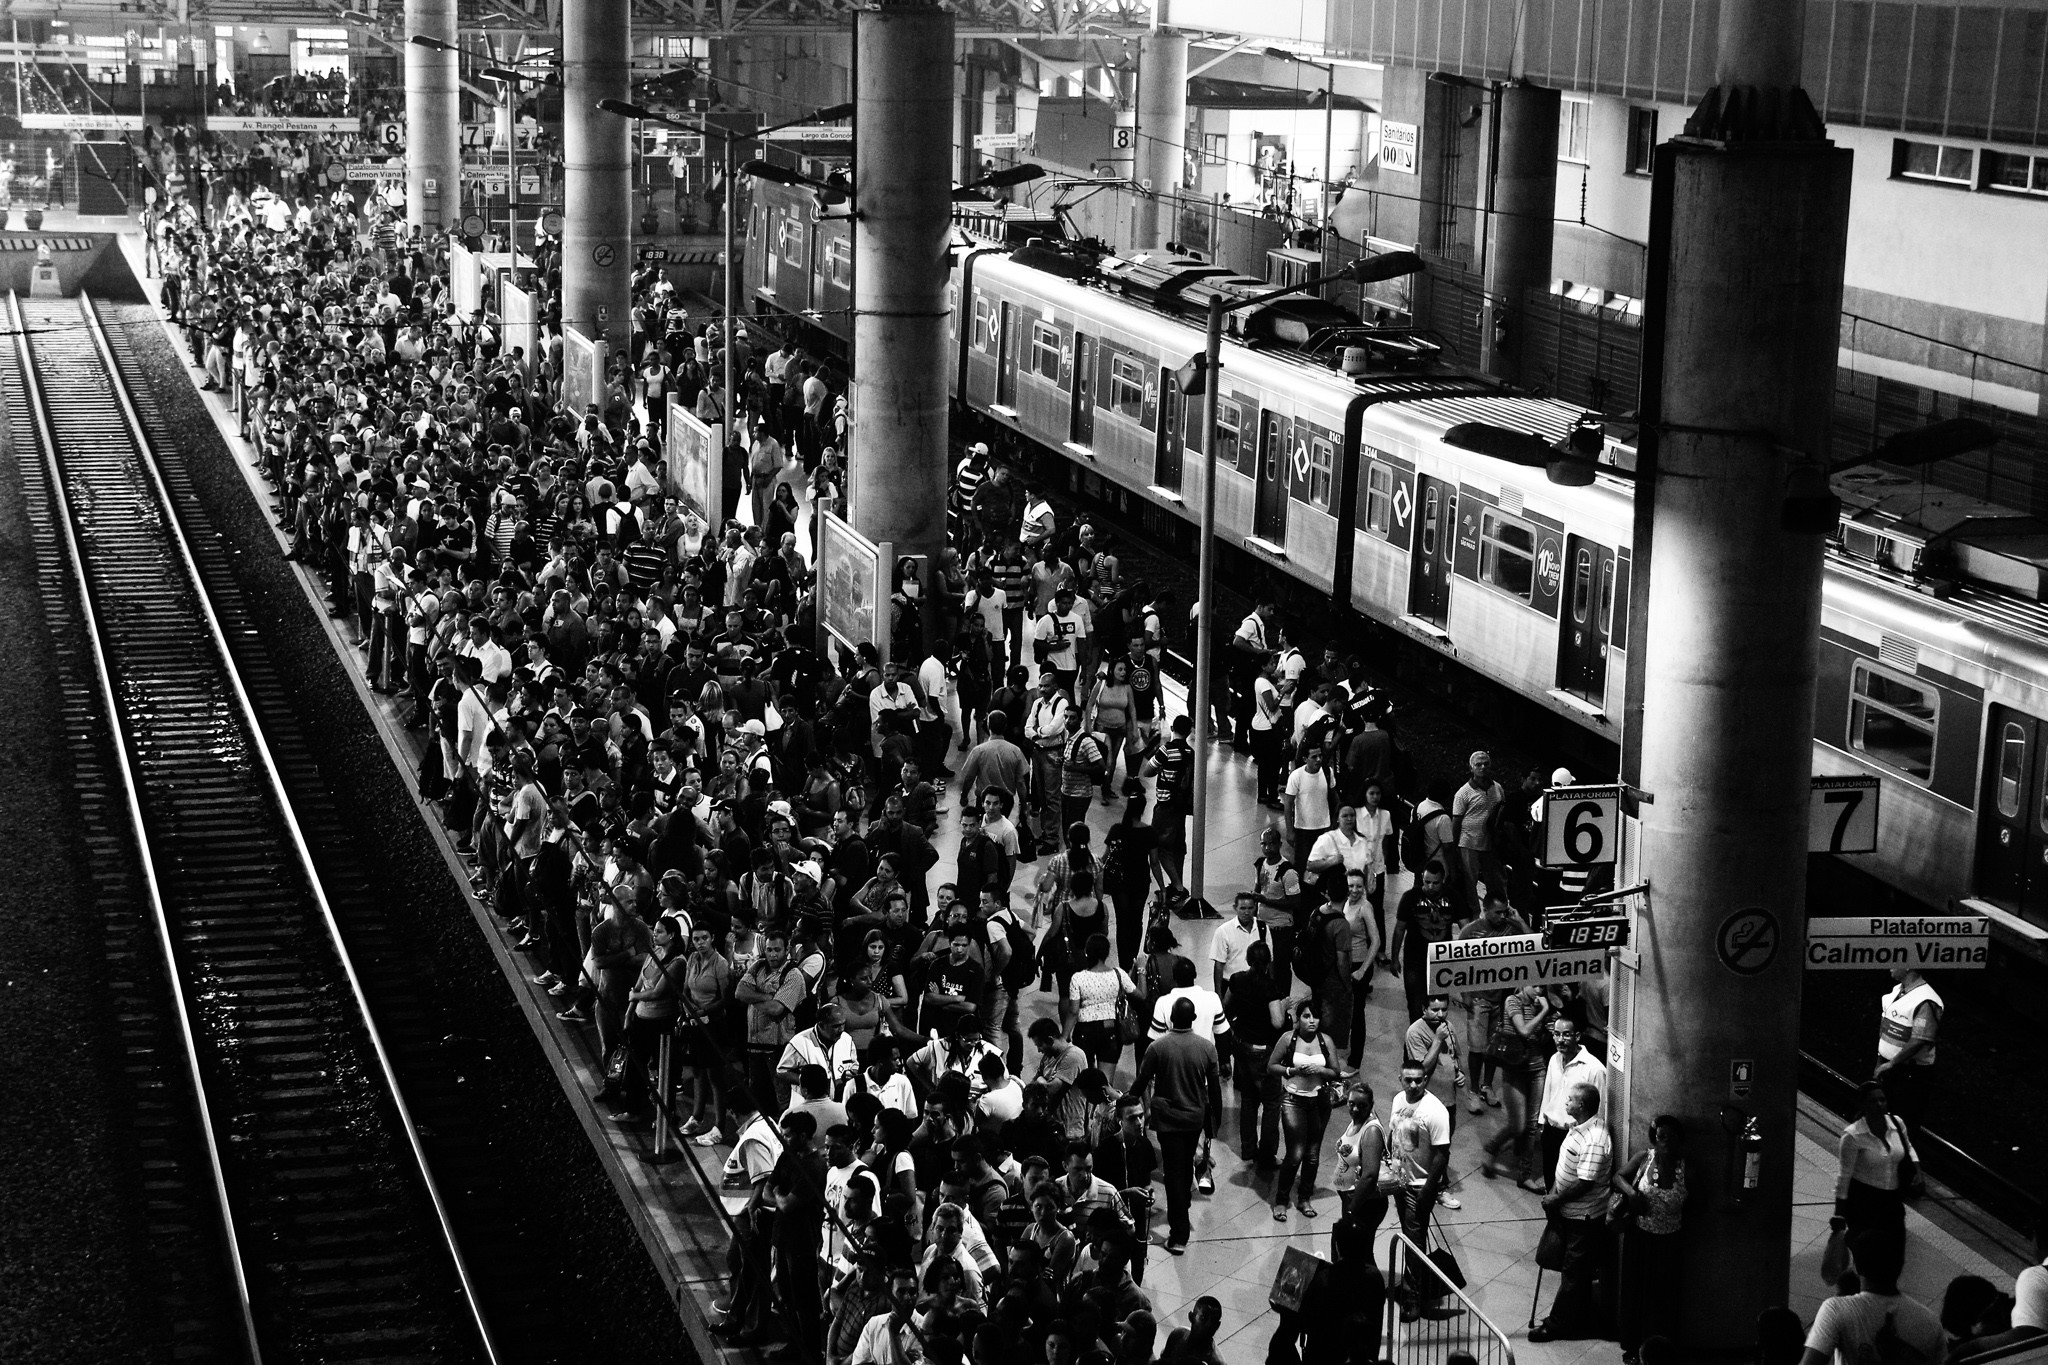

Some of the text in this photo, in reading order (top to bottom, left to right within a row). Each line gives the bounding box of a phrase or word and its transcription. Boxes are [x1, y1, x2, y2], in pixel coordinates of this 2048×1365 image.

[242, 122, 255, 130] Av.
[256, 122, 285, 132] Rangel
[385, 125, 399, 143] 6
[466, 126, 479, 145] 7
[1383, 124, 1415, 143] Sanitários
[1117, 130, 1129, 149] 8
[348, 171, 379, 179] Calmon
[492, 183, 499, 192] 6
[527, 183, 534, 192] 7
[1811, 780, 1878, 789] PLATAFORMA
[1549, 791, 1618, 800] PLATAFORMA
[1823, 790, 1864, 851] 7
[1563, 801, 1604, 864] 6
[1870, 918, 1989, 935] Plataforma 7
[1435, 938, 1536, 961] Plataforma
[1808, 942, 1988, 964] Calmon Viana
[1435, 957, 1603, 989] Calmon Viana
